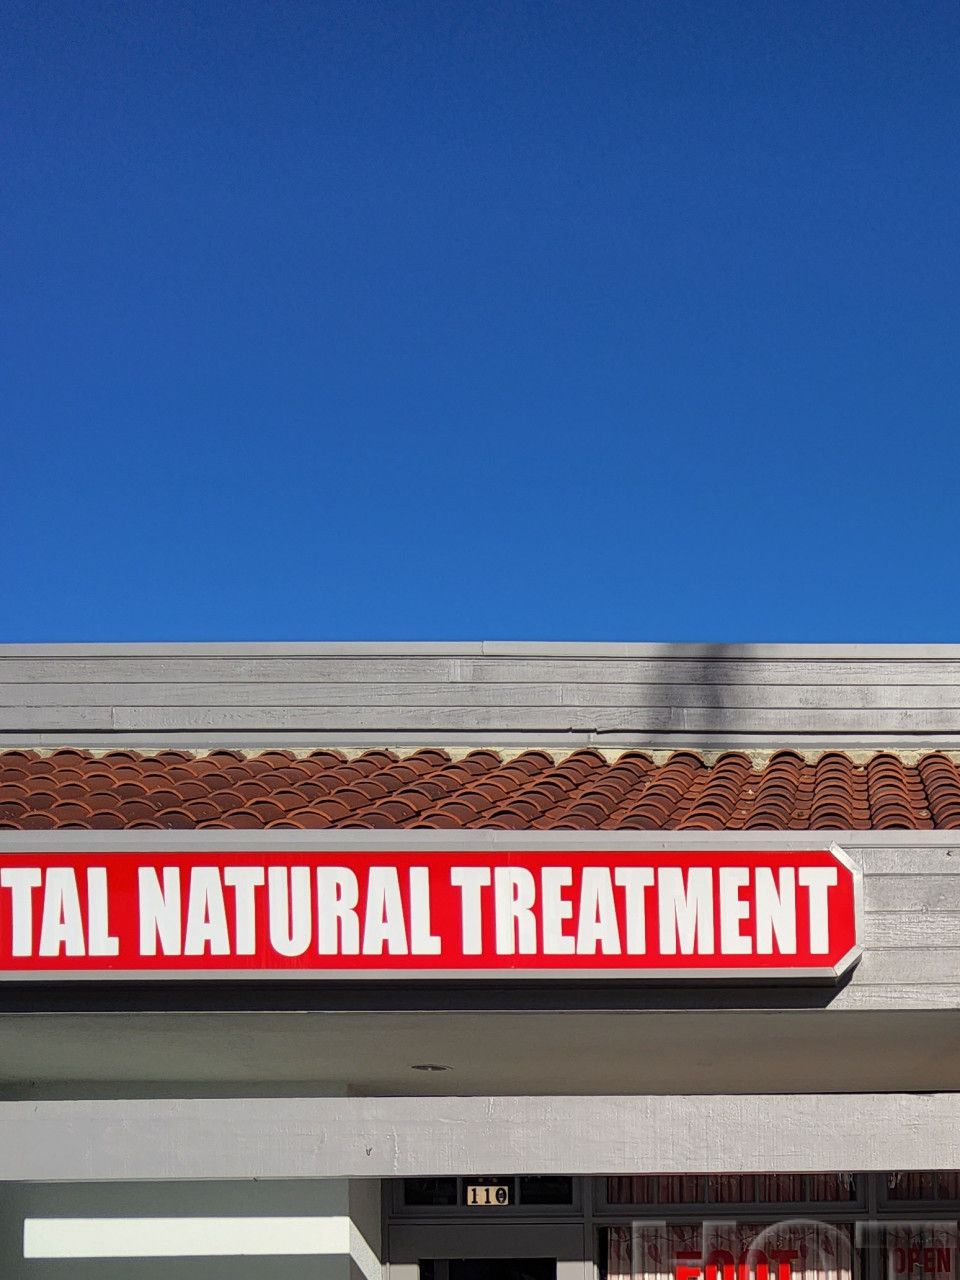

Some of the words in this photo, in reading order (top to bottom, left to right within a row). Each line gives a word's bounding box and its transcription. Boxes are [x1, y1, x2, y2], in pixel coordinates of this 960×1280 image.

[0, 867, 119, 956] TAL
[138, 866, 441, 956] NATURAL
[450, 866, 838, 955] TREATMENT
[471, 1187, 507, 1204] 110
[893, 1247, 951, 1273] OPEN
